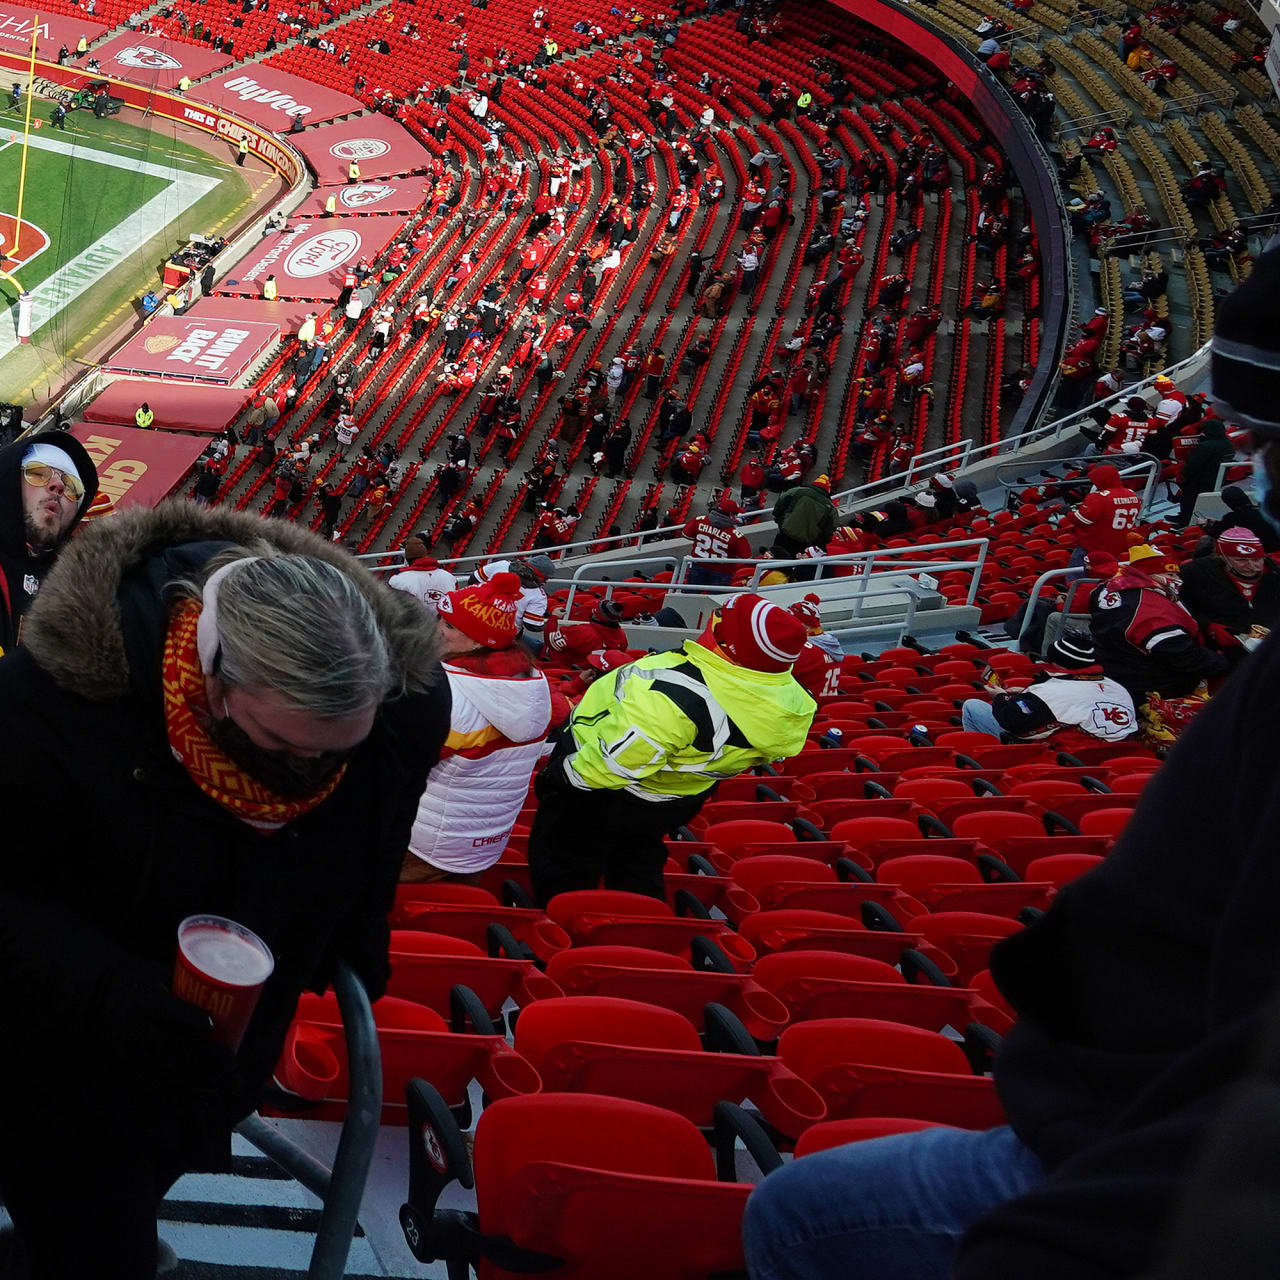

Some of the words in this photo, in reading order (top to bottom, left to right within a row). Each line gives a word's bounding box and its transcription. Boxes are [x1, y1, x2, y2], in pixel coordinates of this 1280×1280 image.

[184, 108, 205, 123] THIS
[205, 115, 216, 127] IS
[295, 238, 350, 267] Ford
[166, 328, 218, 363] BACK
[213, 328, 250, 357] RUN
[194, 353, 225, 371] IT
[1112, 508, 1140, 530] 63
[694, 533, 729, 558] 25
[698, 522, 732, 544] CHARLES
[406, 1218, 419, 1247] 23
